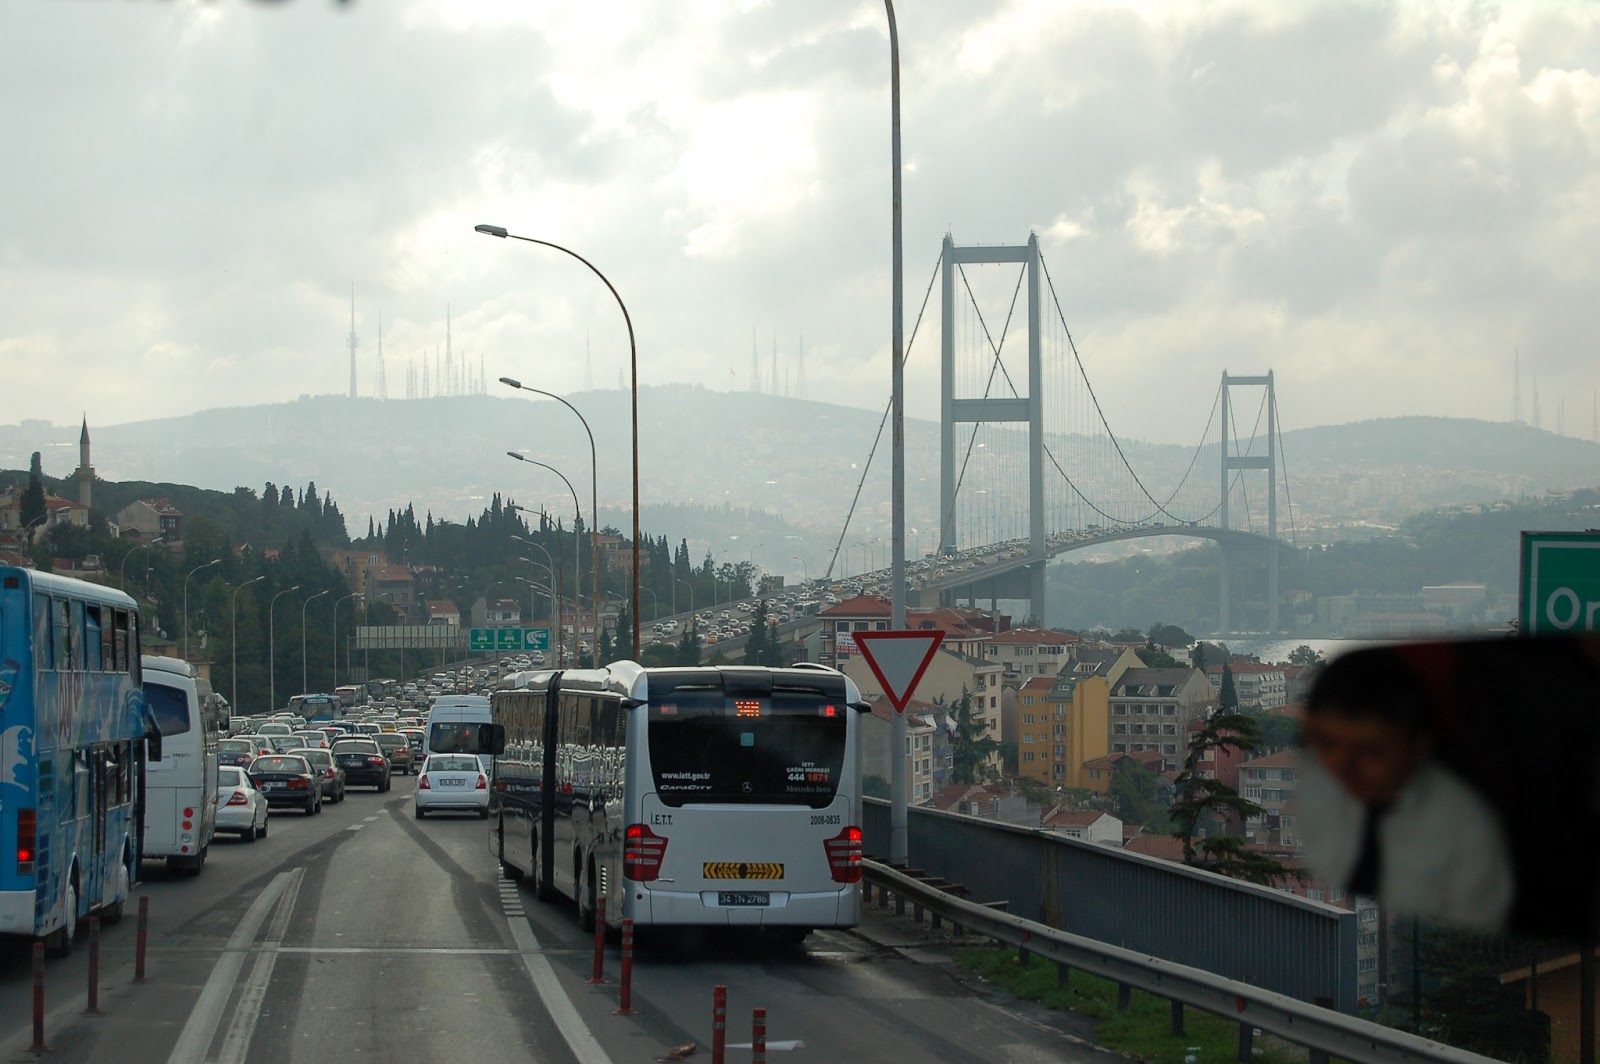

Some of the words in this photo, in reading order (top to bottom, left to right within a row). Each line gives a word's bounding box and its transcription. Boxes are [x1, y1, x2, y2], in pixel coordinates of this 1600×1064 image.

[661, 772, 710, 781] www.iett.gov.tr
[788, 773, 805, 781] 444
[807, 773, 829, 782] 1871
[810, 815, 841, 825] 2008-0835
